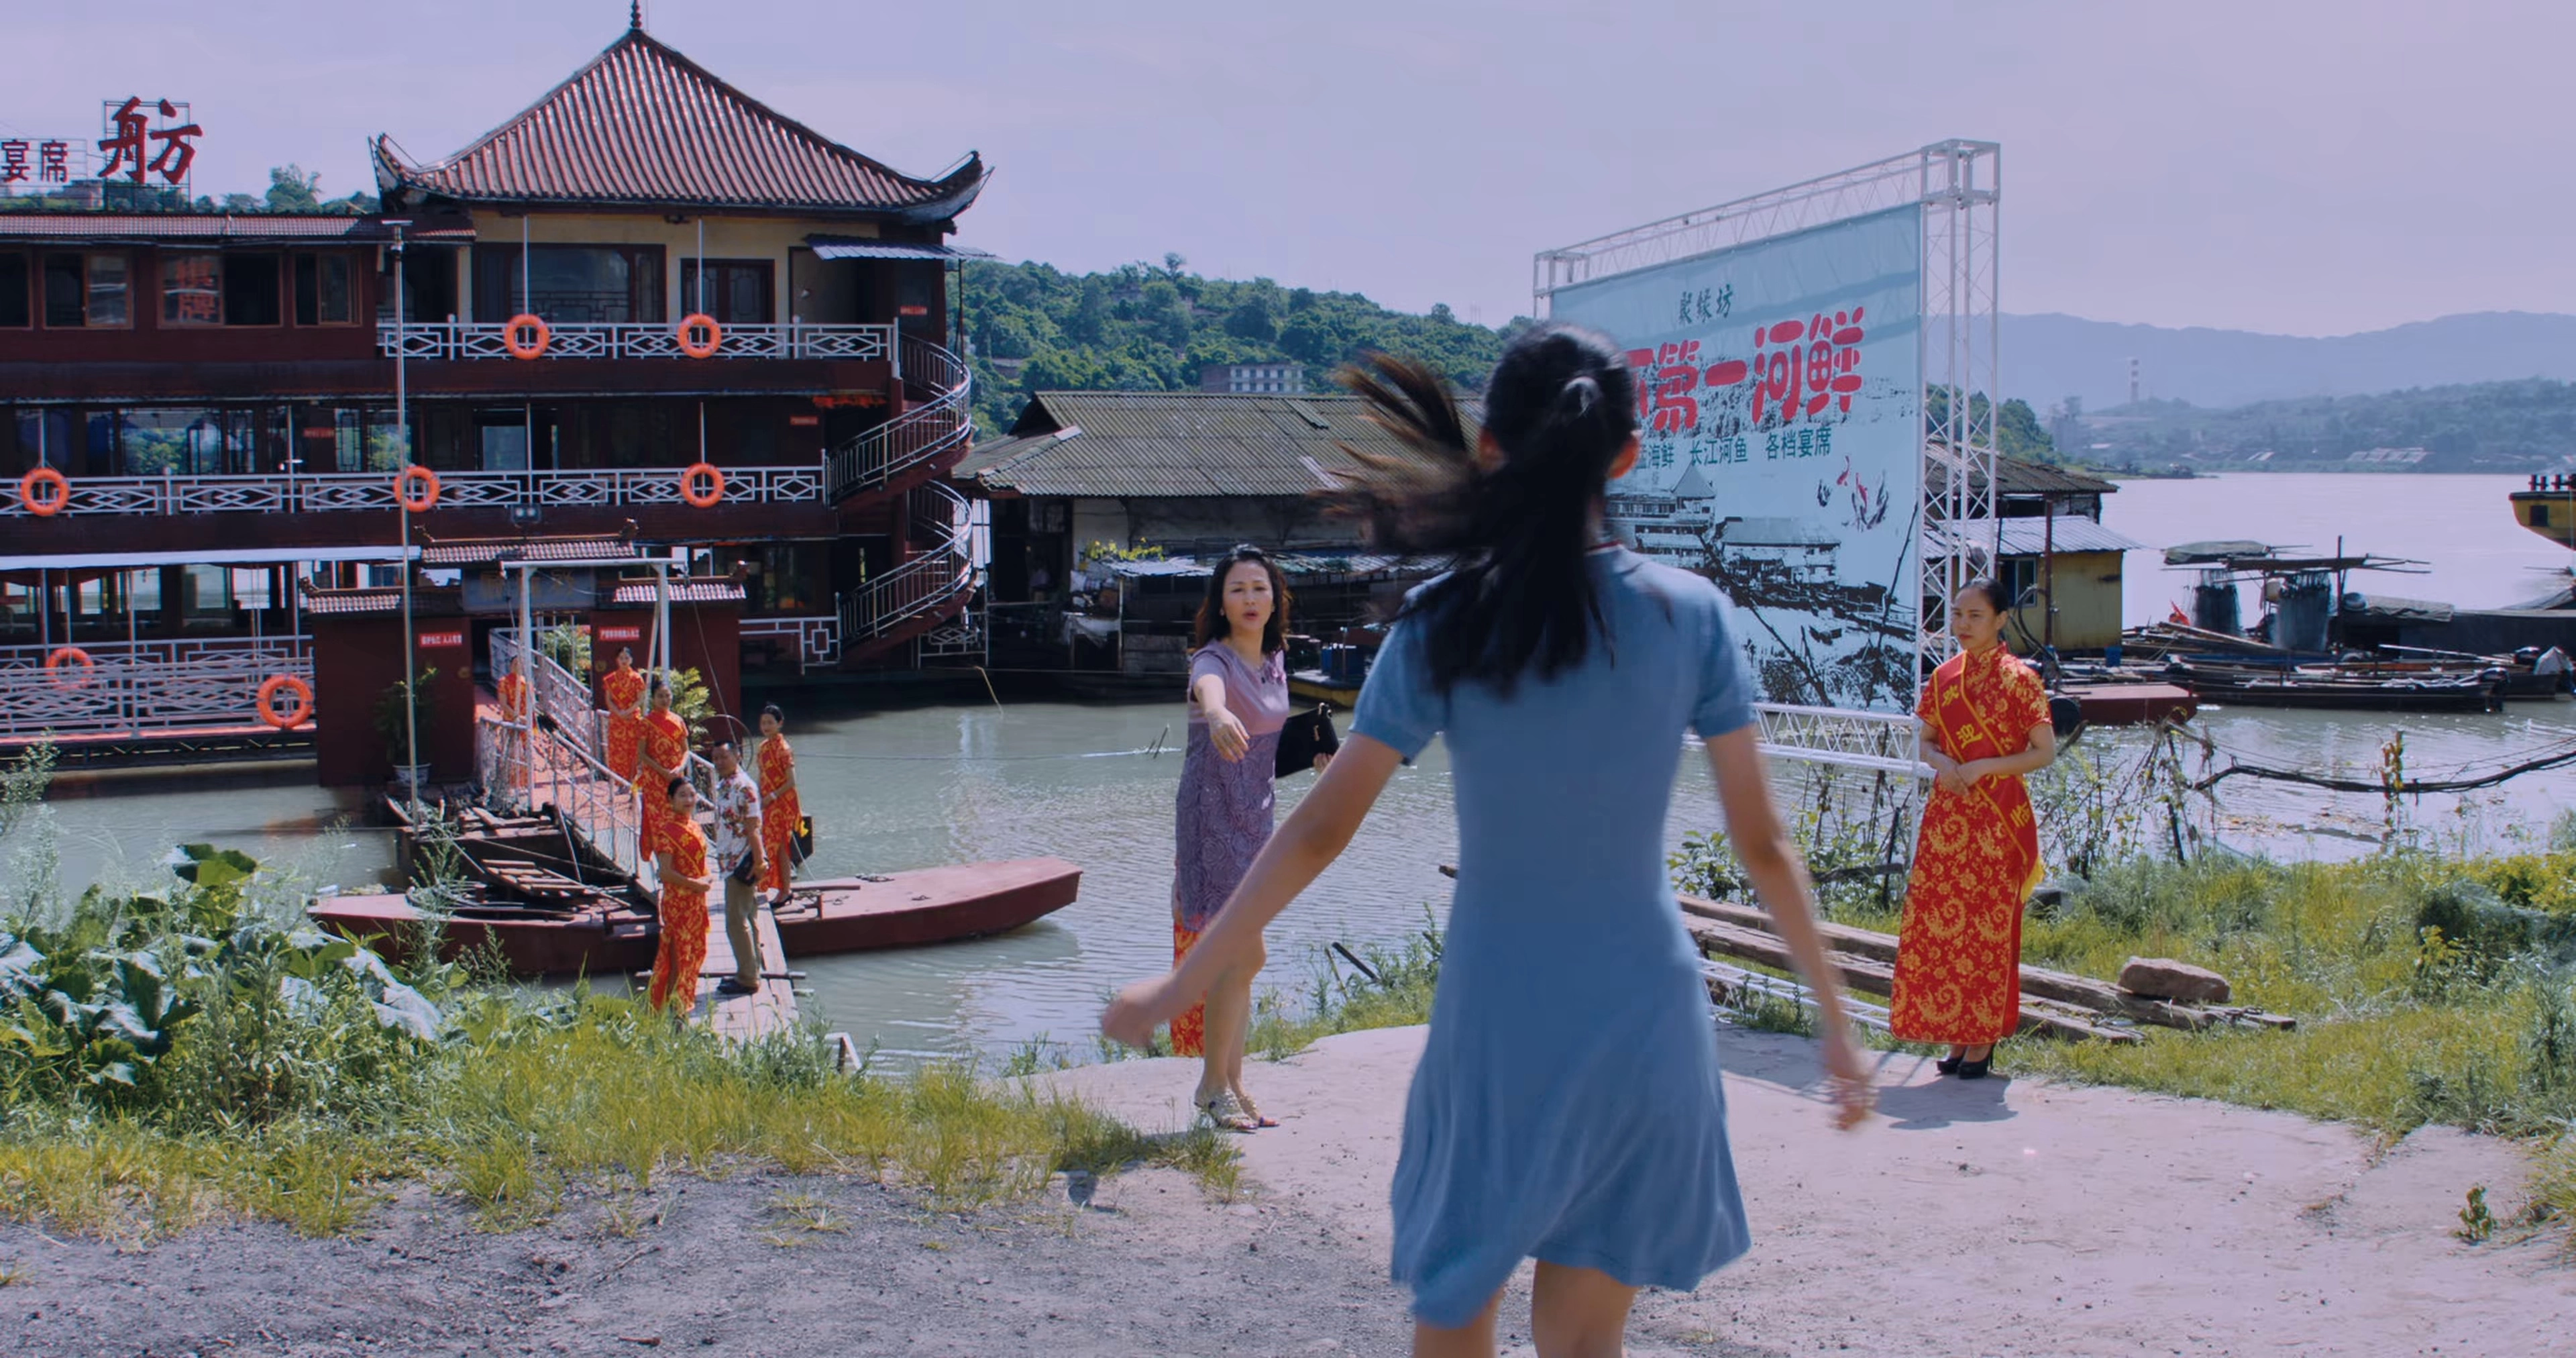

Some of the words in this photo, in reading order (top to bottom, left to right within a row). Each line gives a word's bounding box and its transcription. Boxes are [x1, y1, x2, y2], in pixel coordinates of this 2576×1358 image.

[0, 139, 68, 182] 宴席
[98, 96, 203, 185] 舫
[1689, 435, 1748, 466] 长江河鱼
[1766, 425, 1832, 461] 各档宴席
